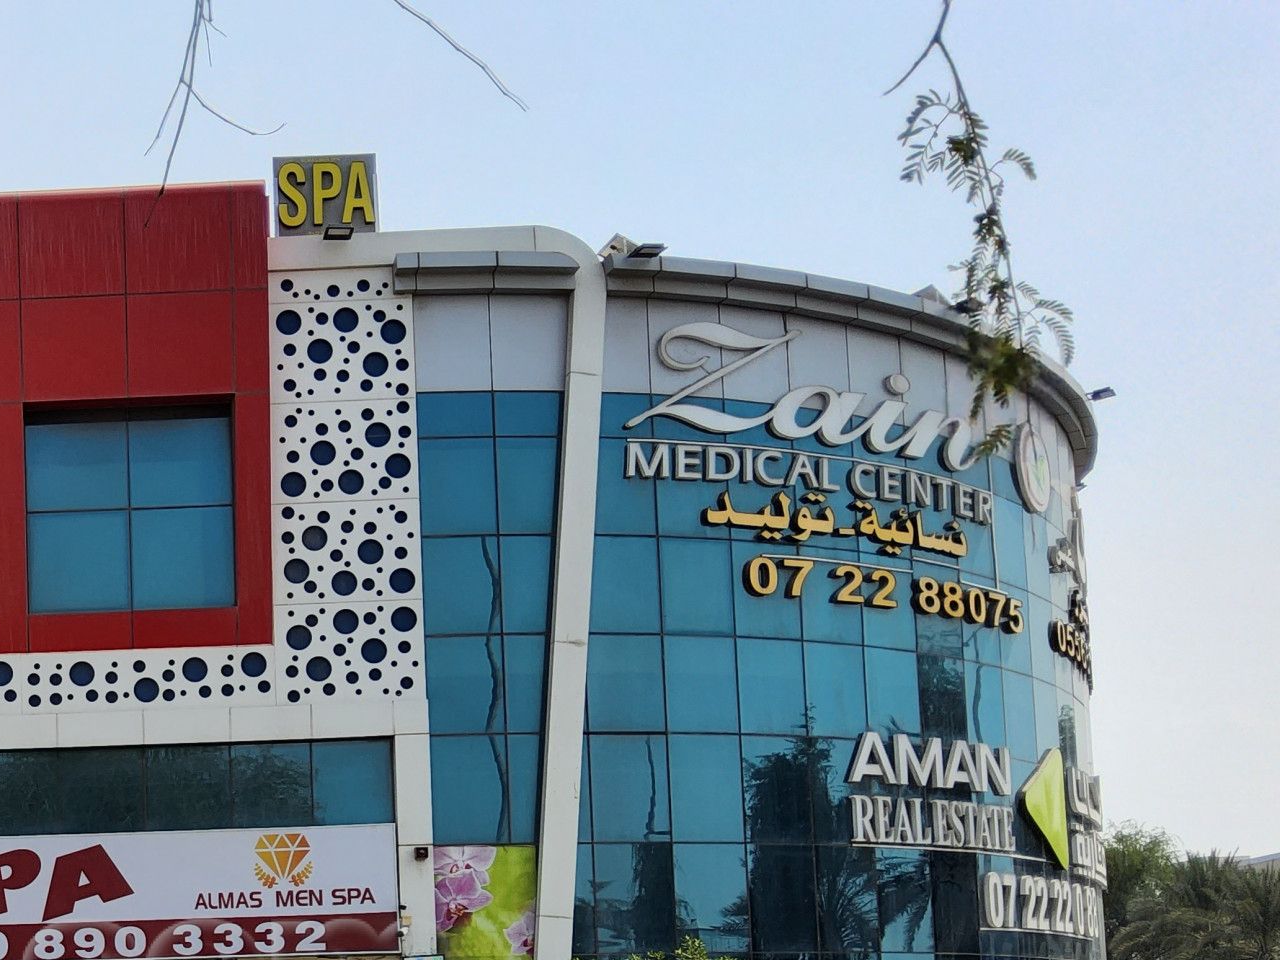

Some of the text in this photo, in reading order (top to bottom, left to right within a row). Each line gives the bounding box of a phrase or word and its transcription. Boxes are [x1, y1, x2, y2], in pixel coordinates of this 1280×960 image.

[278, 161, 376, 227] SPA
[624, 321, 980, 472] Zain
[625, 442, 993, 527] MEDICAL CENTER
[747, 556, 814, 598] 07
[831, 564, 898, 609] 22
[916, 576, 1025, 635] 88075
[846, 731, 1012, 796] AMAN
[194, 886, 376, 910] ALMAS MEN SPA
[33, 925, 147, 960] 890
[172, 920, 327, 957] 3332
